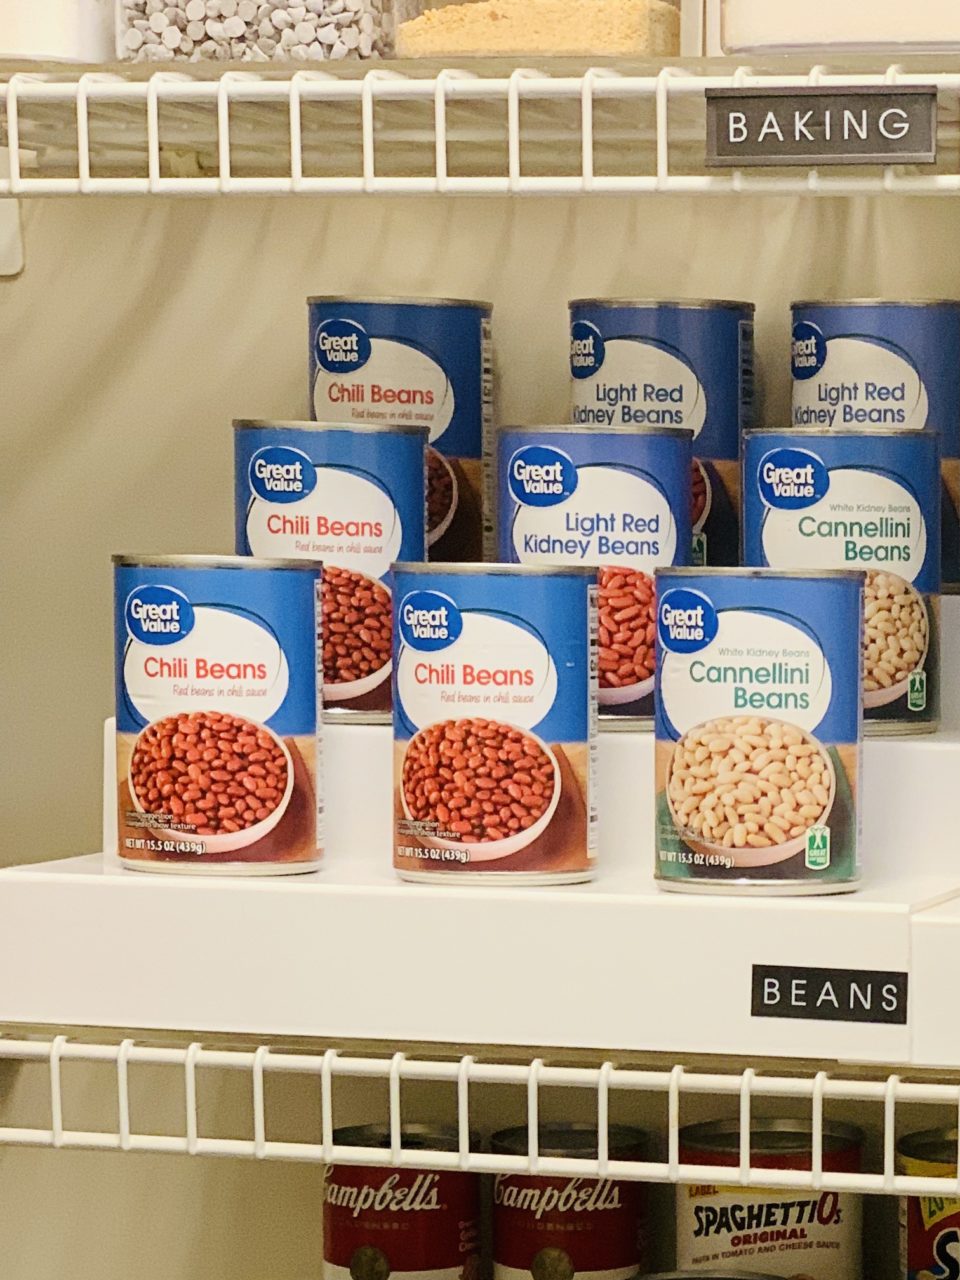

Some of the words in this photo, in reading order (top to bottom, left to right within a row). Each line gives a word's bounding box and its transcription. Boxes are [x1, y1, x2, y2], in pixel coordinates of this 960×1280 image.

[728, 108, 910, 143] BAKING
[328, 383, 364, 404] Chili
[372, 385, 434, 405] Beans
[818, 383, 859, 404] Light
[865, 383, 905, 401] Red
[843, 405, 905, 423] Beans
[763, 463, 814, 484] Great
[773, 481, 814, 498] Value
[267, 514, 308, 536] Chili
[317, 516, 382, 537] Beans
[566, 513, 614, 536] Light
[622, 514, 659, 533] Red
[798, 516, 910, 539] Cannellini
[524, 535, 591, 558] Kidney
[598, 536, 659, 555] Beans
[844, 541, 910, 562] Beans
[131, 599, 180, 622] Great
[403, 604, 449, 627] Great
[661, 603, 704, 627] Great
[141, 618, 180, 634] Value
[411, 624, 449, 640] Value
[669, 624, 704, 641] Value
[718, 648, 744, 658] White
[746, 648, 780, 660] Kidney
[782, 648, 810, 658] Beans
[143, 656, 188, 679] Chili
[195, 657, 268, 679] Beans
[414, 663, 456, 686] Chili
[463, 664, 534, 686] Beans
[689, 660, 810, 685] Cannellini
[172, 685, 189, 697] Red
[189, 685, 215, 698] beans
[733, 687, 809, 710] Beans
[146, 840, 162, 850] 15.5
[163, 841, 175, 851] OZ
[176, 842, 206, 854] (439g)
[763, 978, 898, 1011] BEANS
[731, 1228, 807, 1247] ORIGINAL
